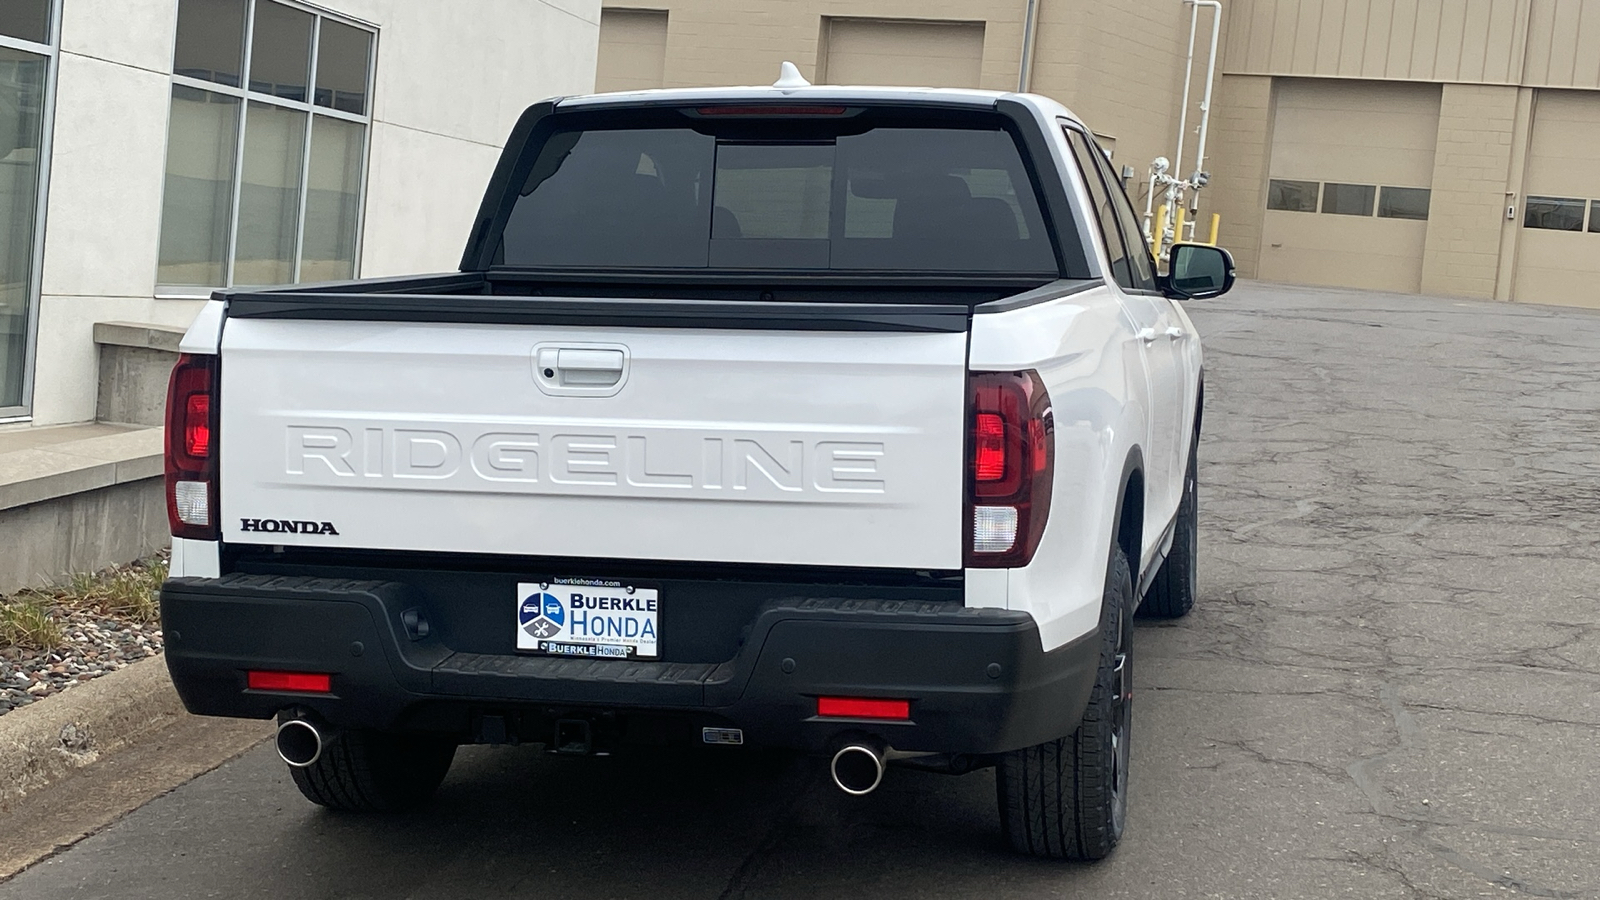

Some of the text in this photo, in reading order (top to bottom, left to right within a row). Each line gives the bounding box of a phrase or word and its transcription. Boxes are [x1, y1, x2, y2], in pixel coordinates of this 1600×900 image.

[284, 424, 887, 495] RIDGELINE
[240, 518, 340, 536] HONDA
[554, 577, 620, 587] buerklehonda.com
[570, 593, 657, 612] BUERKLE
[570, 610, 656, 639] HONDA
[549, 643, 626, 656] BUERKLE HONDA
